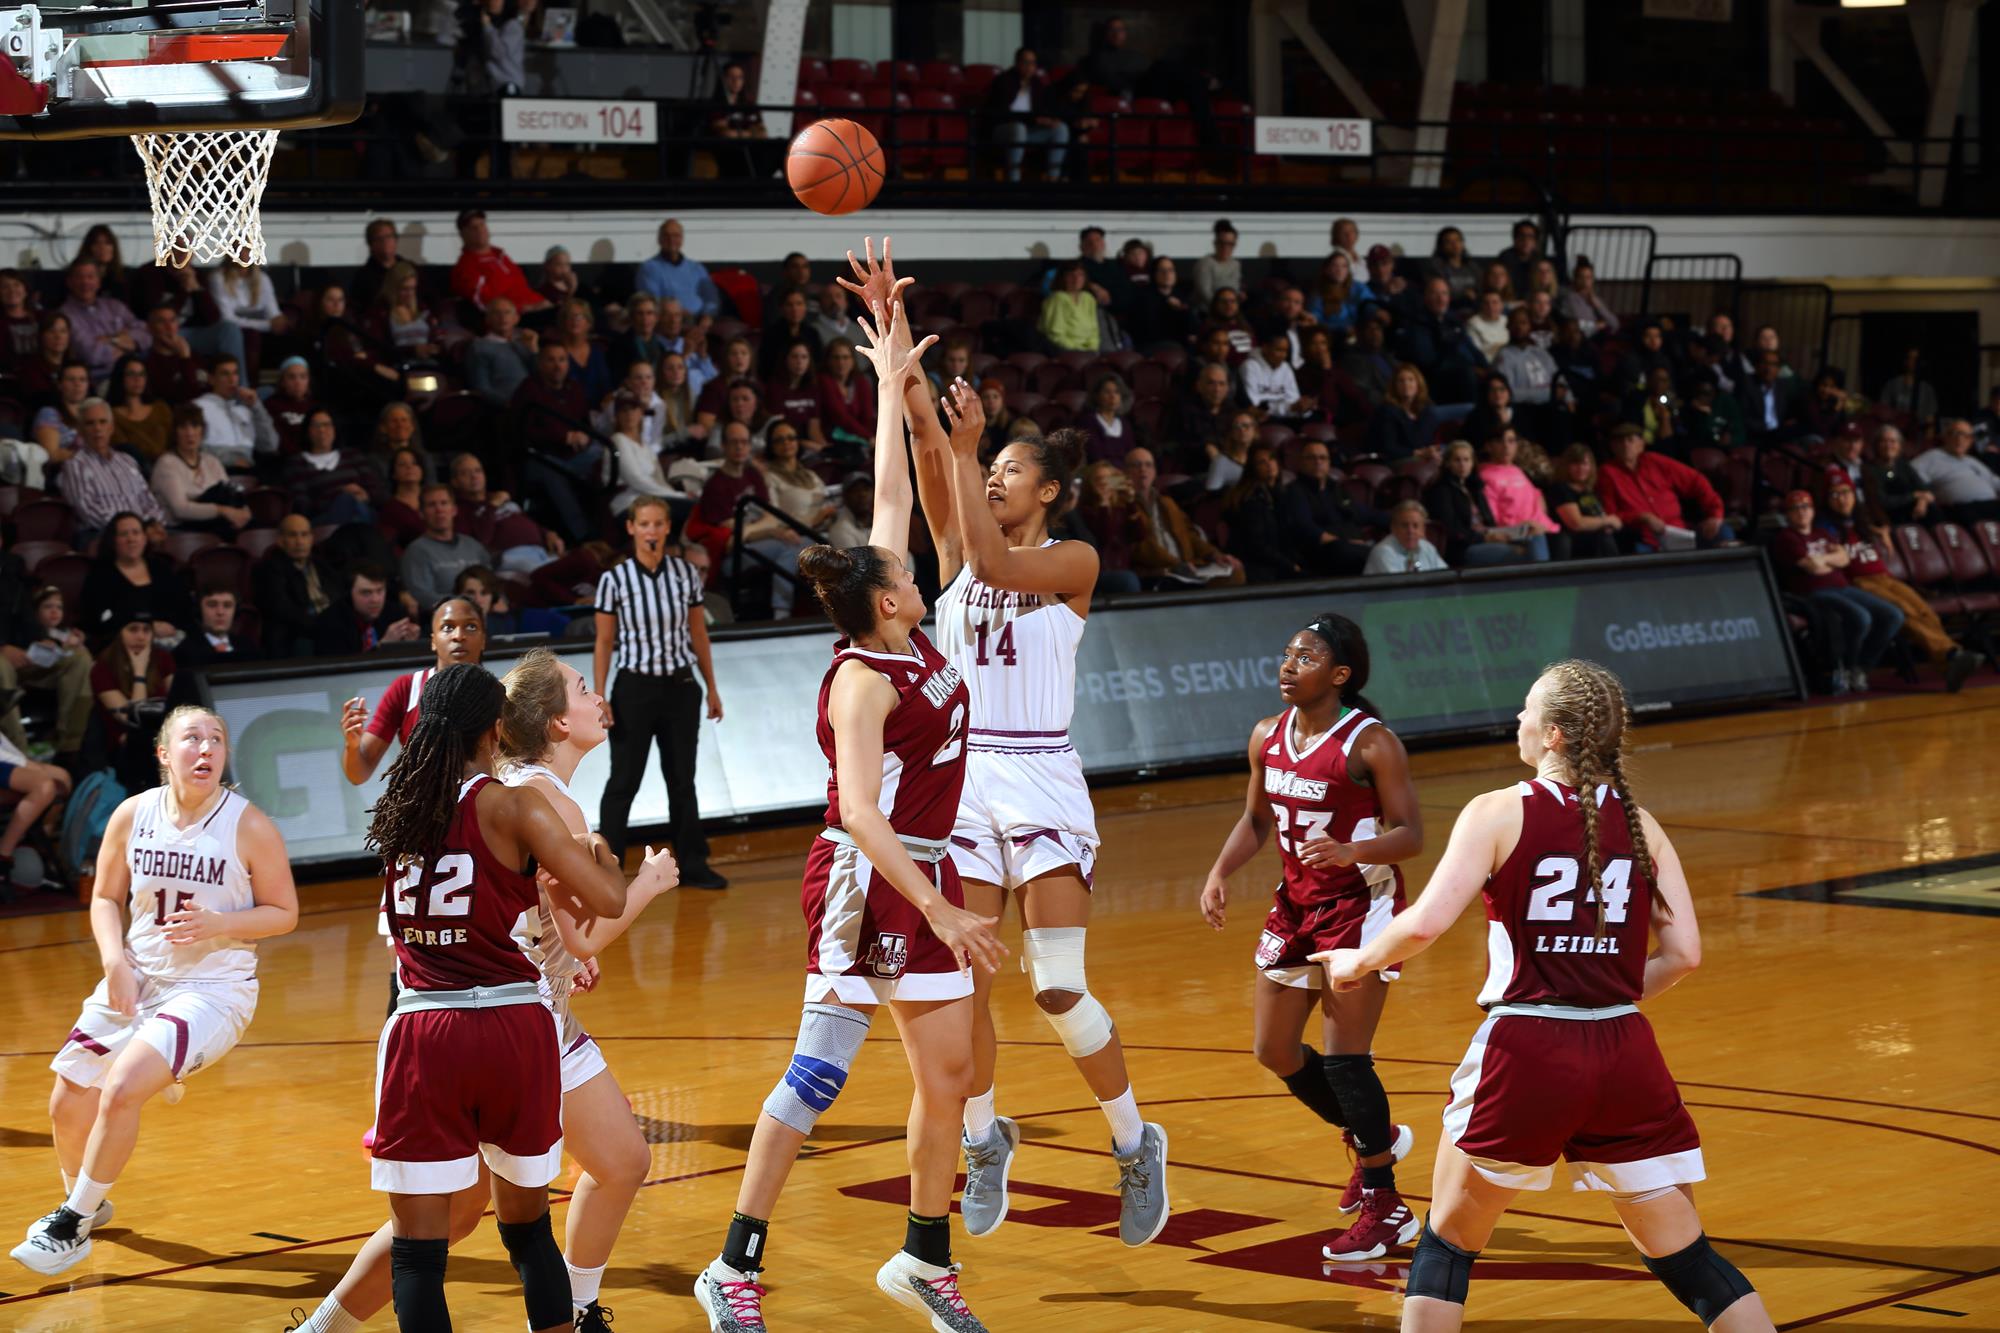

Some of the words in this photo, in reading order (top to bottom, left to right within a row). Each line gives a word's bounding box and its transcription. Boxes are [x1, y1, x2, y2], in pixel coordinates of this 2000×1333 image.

[518, 111, 588, 129] SECTION
[598, 106, 642, 138] 104
[1266, 127, 1319, 144] SECTION
[1327, 122, 1361, 151] 105
[975, 621, 1017, 666] 14
[1383, 616, 1473, 661] SAVE
[1475, 611, 1537, 653] 15%
[1605, 616, 1761, 652] GoBuses.com
[920, 661, 962, 710] UMAS
[1171, 655, 1282, 696] SERVIC
[932, 703, 965, 766] 2
[133, 847, 227, 886] FORDHAM
[393, 853, 474, 916] 22
[154, 888, 195, 926] 15
[1526, 857, 1633, 923] 24
[399, 927, 468, 946] EORGE
[1535, 935, 1620, 954] LEIDEL
